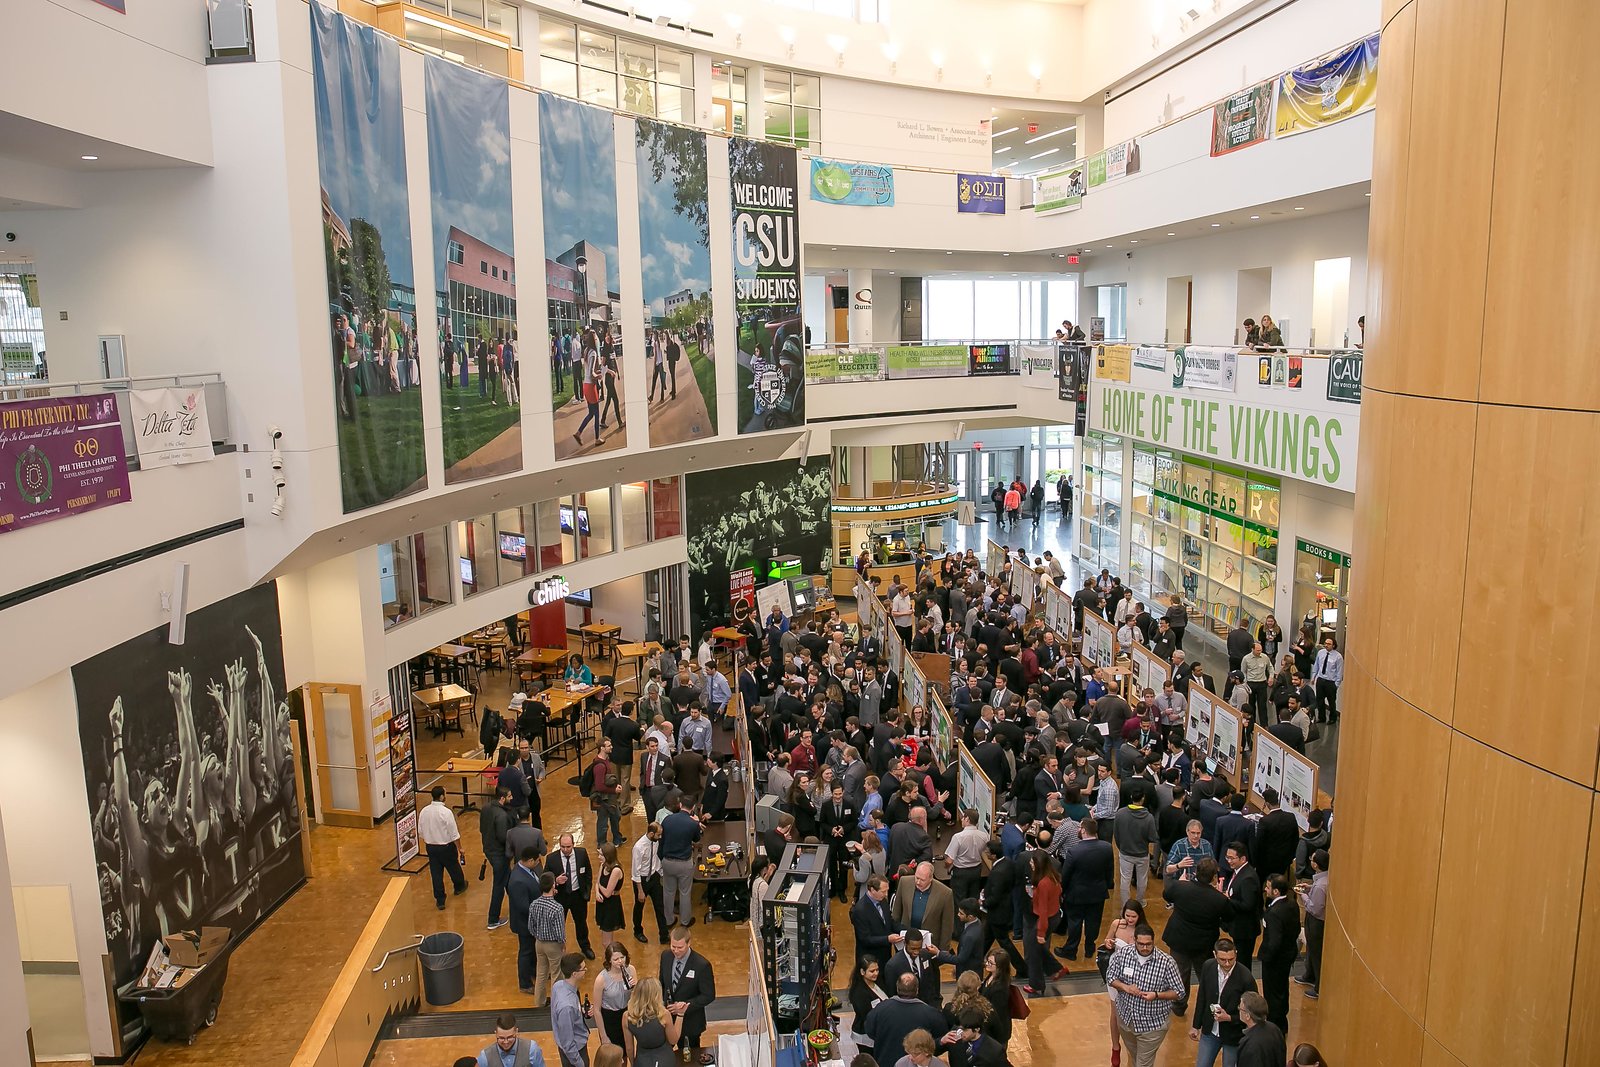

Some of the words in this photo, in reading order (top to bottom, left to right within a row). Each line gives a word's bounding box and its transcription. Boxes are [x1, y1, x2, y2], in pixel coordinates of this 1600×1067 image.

[734, 182, 793, 208] WELCOME
[972, 181, 1004, 197] ΦΣΠ
[736, 213, 794, 267] CSU
[736, 278, 797, 301] STUDENTS
[976, 355, 1004, 363] Alliance
[3, 410, 19, 429] PHI
[141, 411, 176, 436] Delta
[176, 411, 198, 436] Zeta
[18, 426, 44, 440] Essential
[1103, 388, 1146, 438] HOME
[1151, 393, 1175, 443] OF
[1181, 398, 1220, 455] THE
[1229, 405, 1342, 483] VIKINGS
[74, 437, 99, 458] ΦΘ
[59, 464, 71, 472] PHI
[71, 461, 92, 471] THETA
[92, 456, 117, 467] CHAPTER
[80, 479, 91, 487] EST.
[92, 476, 104, 484] 1970
[1161, 476, 1199, 502] VIKNG
[1203, 490, 1237, 514] GEAR
[1305, 544, 1327, 558] BOOKS
[1328, 552, 1333, 560] &
[730, 579, 741, 590] LIVE
[740, 575, 753, 588] MORE
